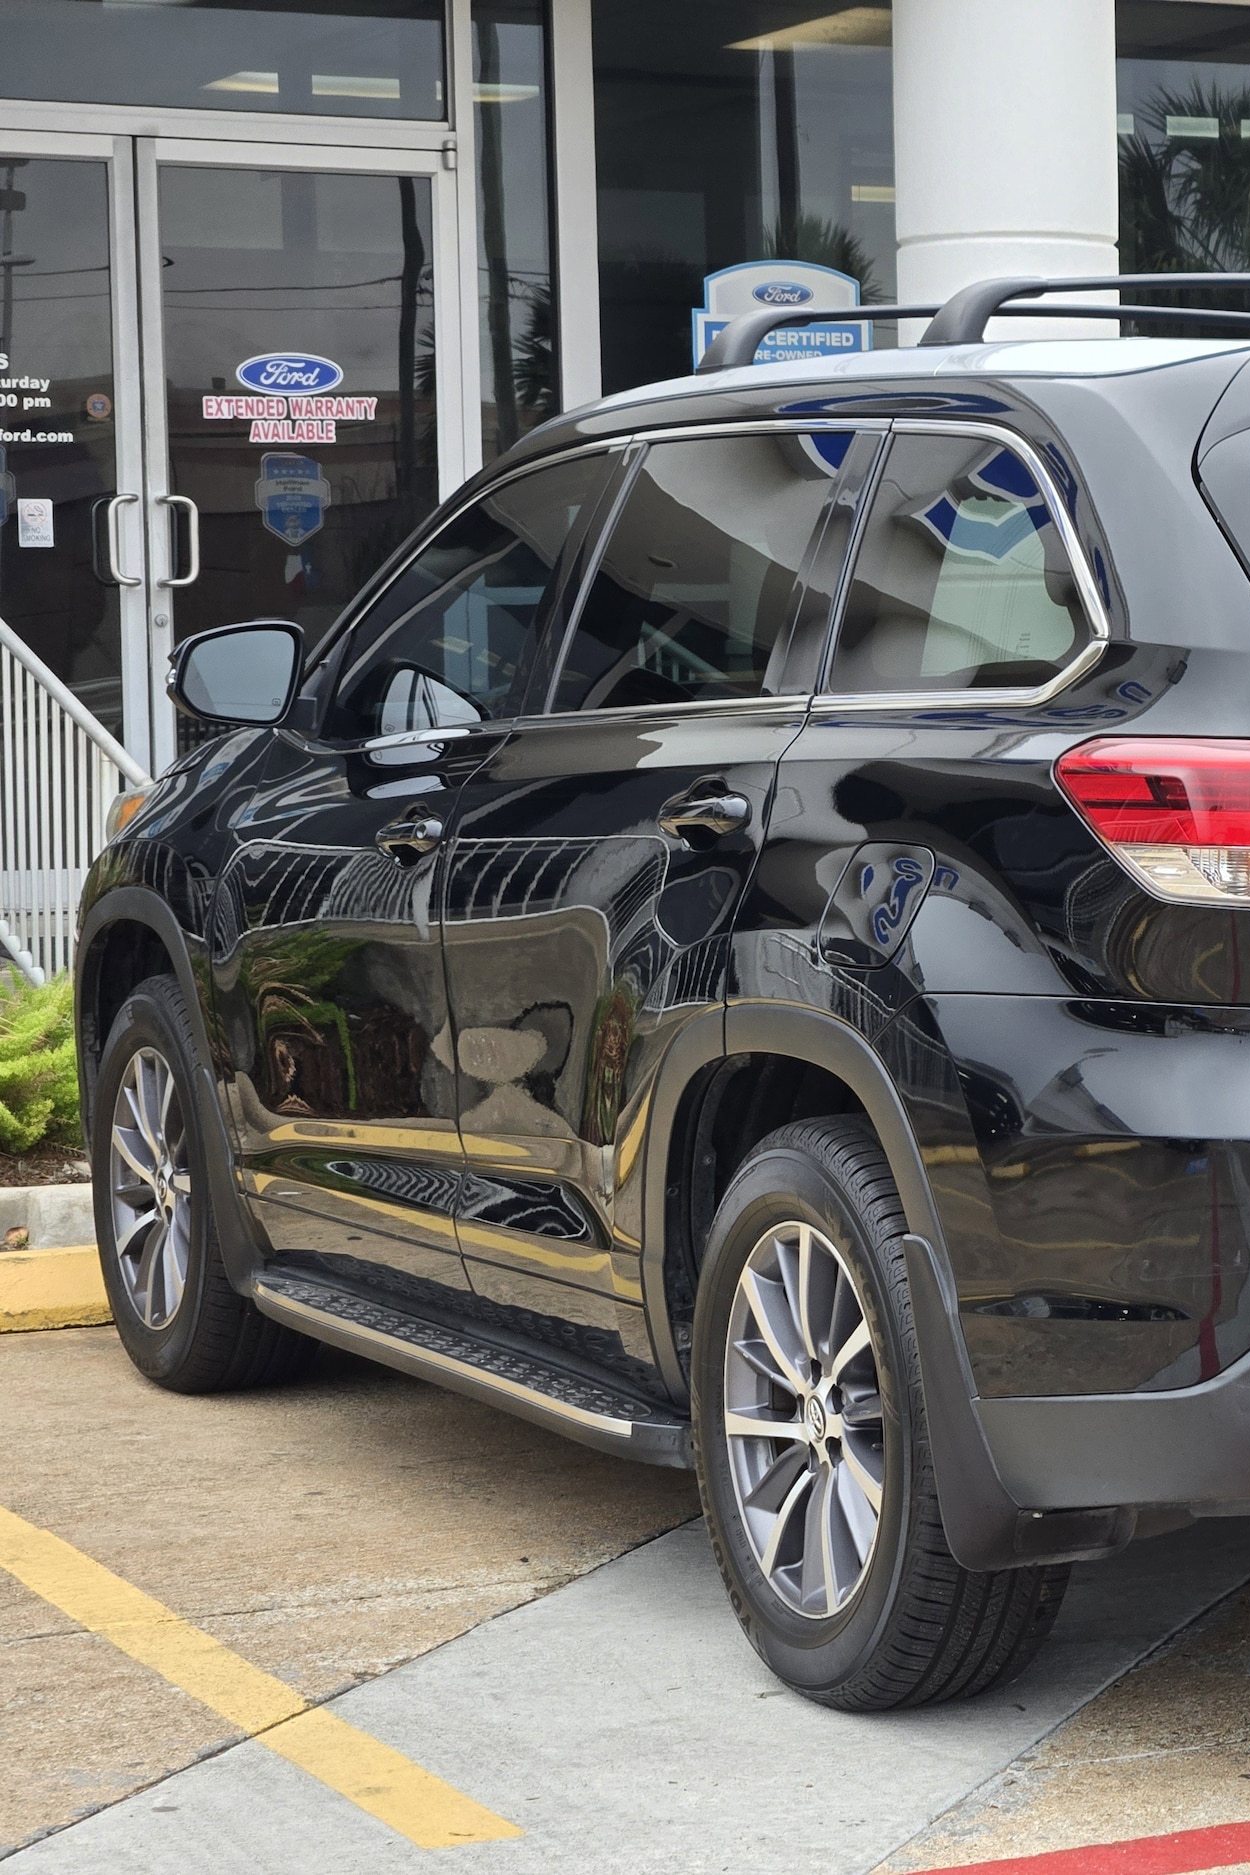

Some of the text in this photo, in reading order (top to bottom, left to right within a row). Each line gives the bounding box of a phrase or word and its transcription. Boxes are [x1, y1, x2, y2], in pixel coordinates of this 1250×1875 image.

[764, 285, 801, 302] Ford
[763, 331, 854, 347] CERTIFIED
[755, 350, 822, 361] RE-OWNED
[259, 360, 320, 386] Ford
[0, 375, 50, 392] urday
[23, 397, 51, 410] pm
[204, 398, 376, 419] EXTENDED WARRANTY
[252, 422, 334, 441] AVAILABLE
